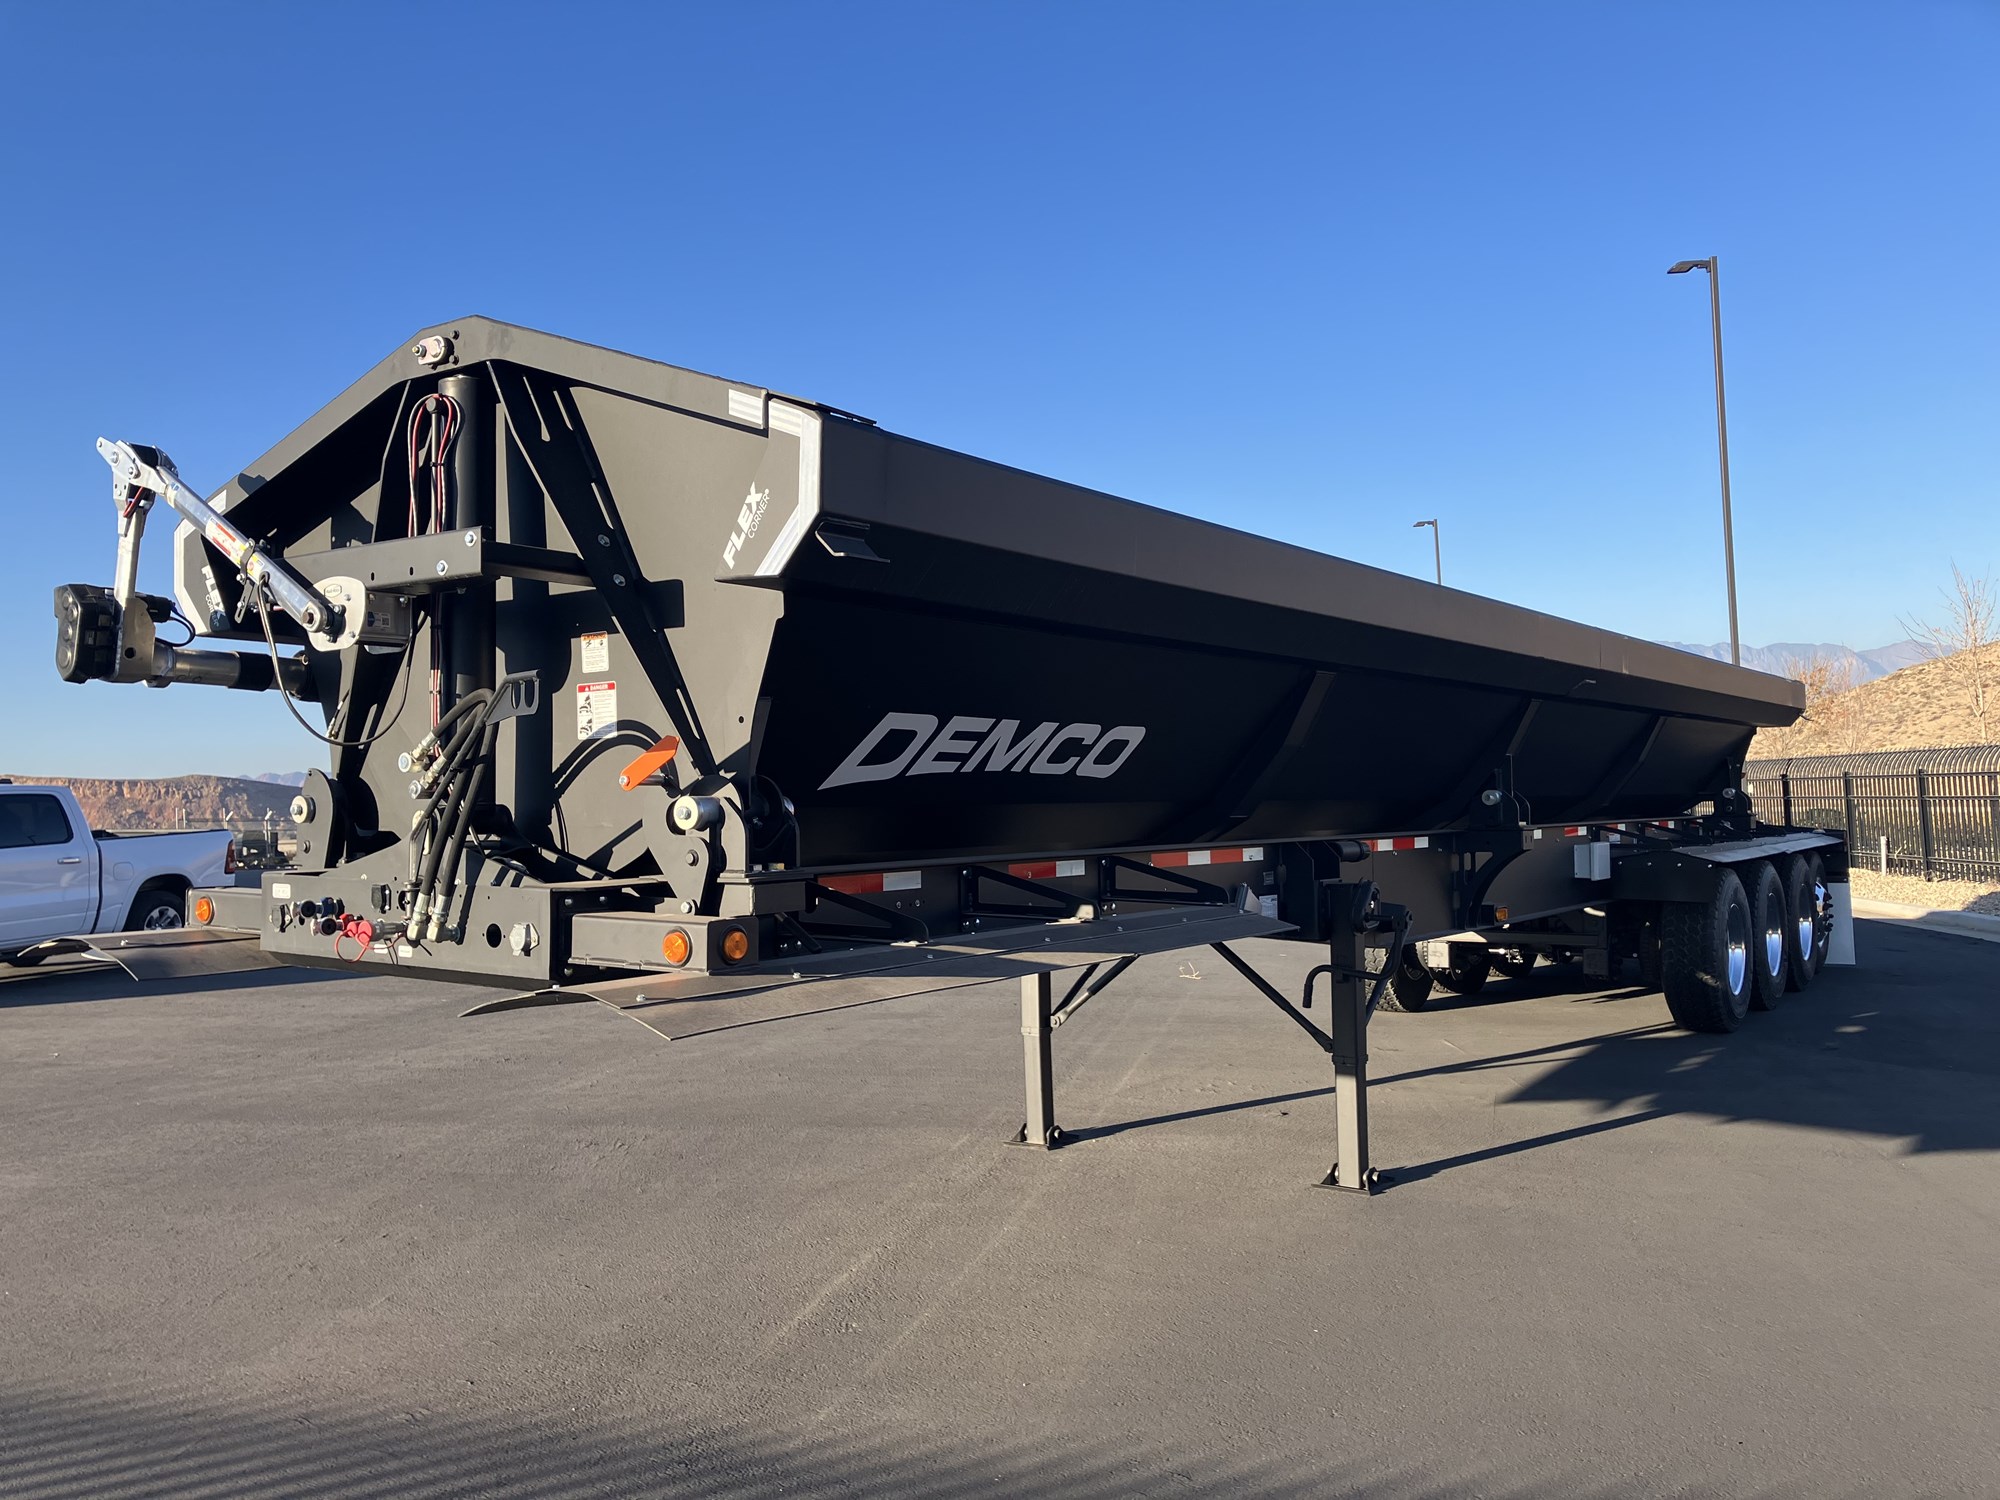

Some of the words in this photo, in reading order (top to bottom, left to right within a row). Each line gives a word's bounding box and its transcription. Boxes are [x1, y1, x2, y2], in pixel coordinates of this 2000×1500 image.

[722, 481, 763, 570] FLEX
[590, 683, 609, 692] DANGER
[817, 712, 1146, 791] DEMCO
